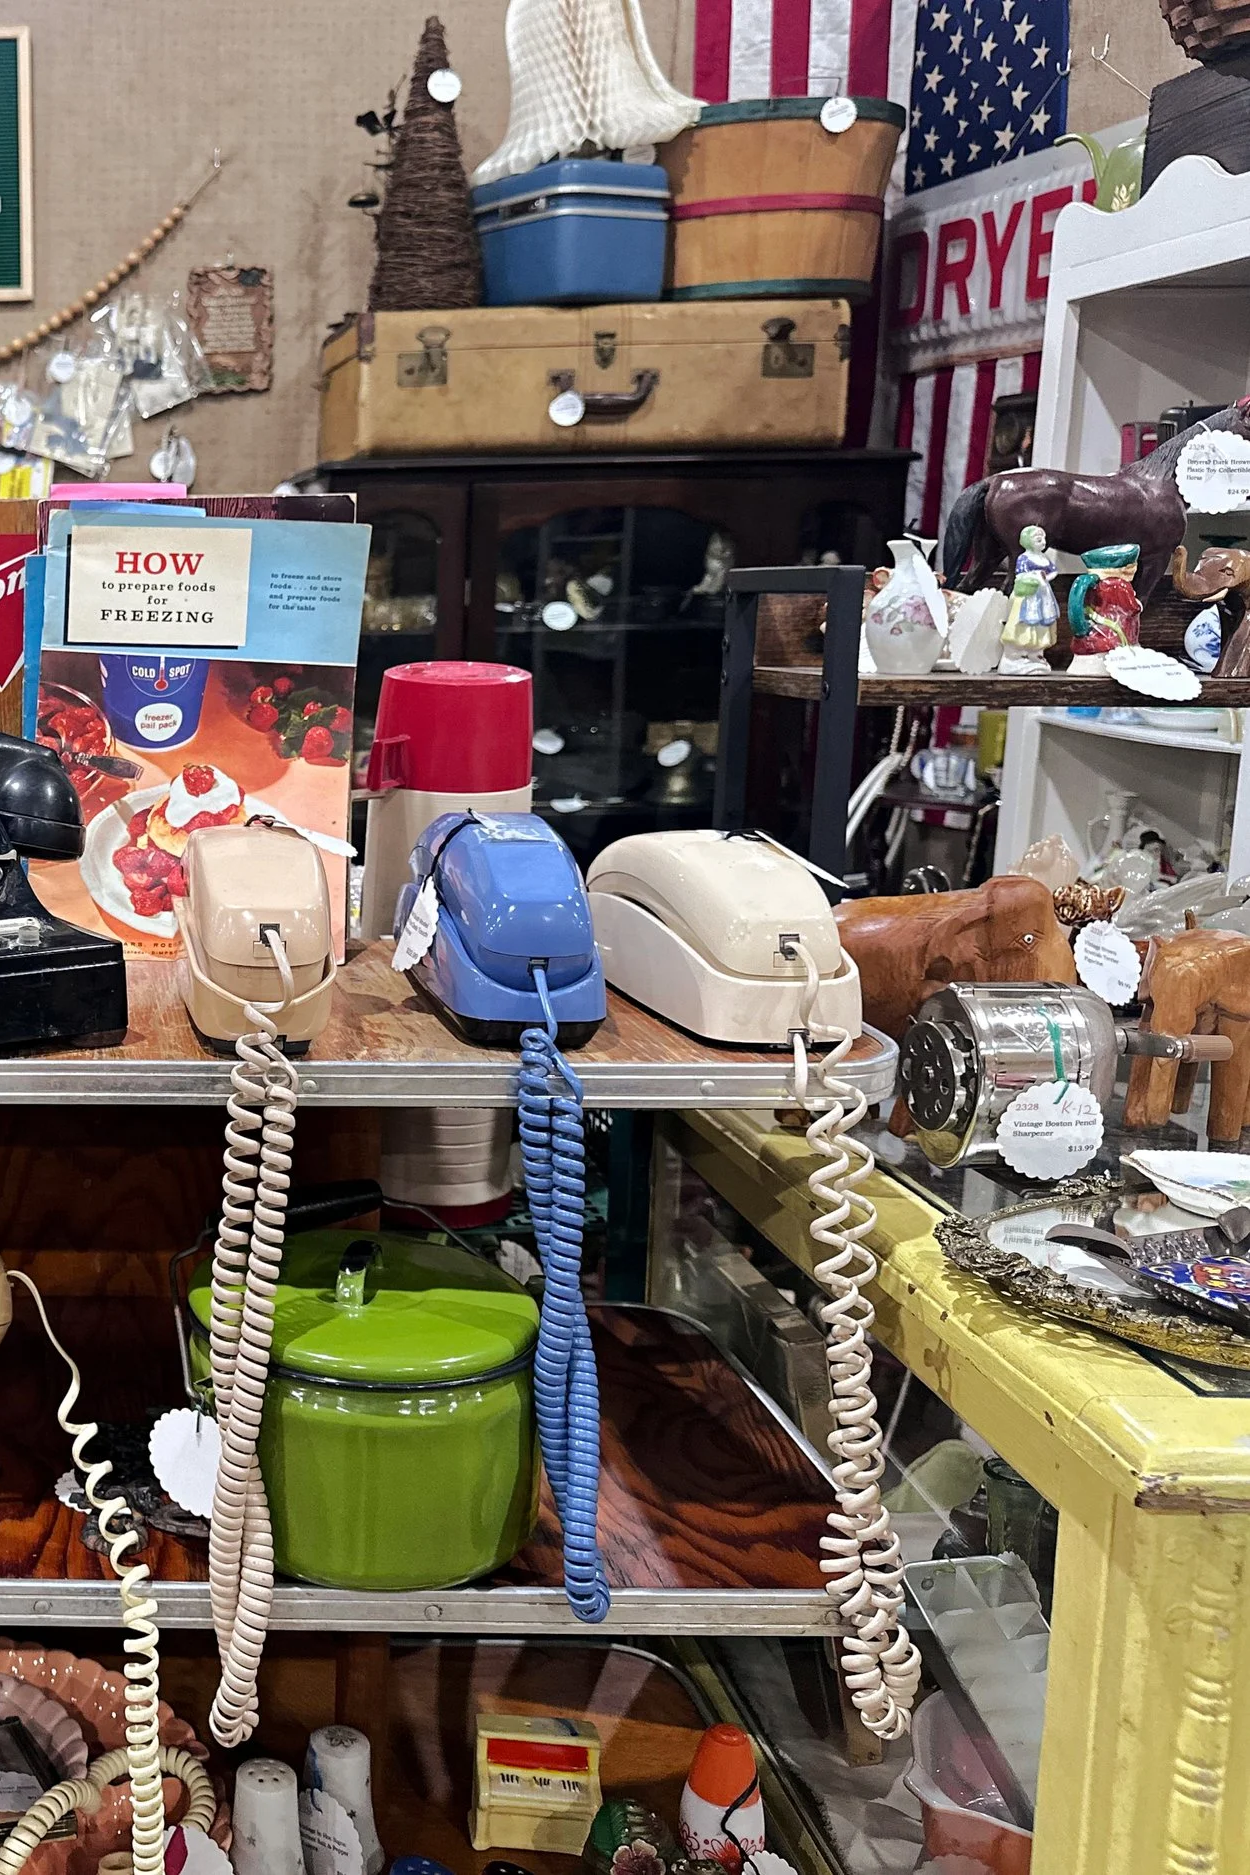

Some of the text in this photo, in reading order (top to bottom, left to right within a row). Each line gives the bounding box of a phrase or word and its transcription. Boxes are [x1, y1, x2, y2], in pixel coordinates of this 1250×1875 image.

[894, 178, 1097, 331] DRYE
[115, 552, 205, 575] HOW
[102, 582, 216, 593] to prepare foods
[147, 595, 168, 606] for
[287, 594, 316, 602] prepare
[100, 609, 215, 624] FREEZING
[132, 663, 191, 679] COLD SPOT
[159, 720, 177, 729] pack
[1015, 1103, 1039, 1111] 2328
[1068, 1144, 1094, 1152] $13.99
